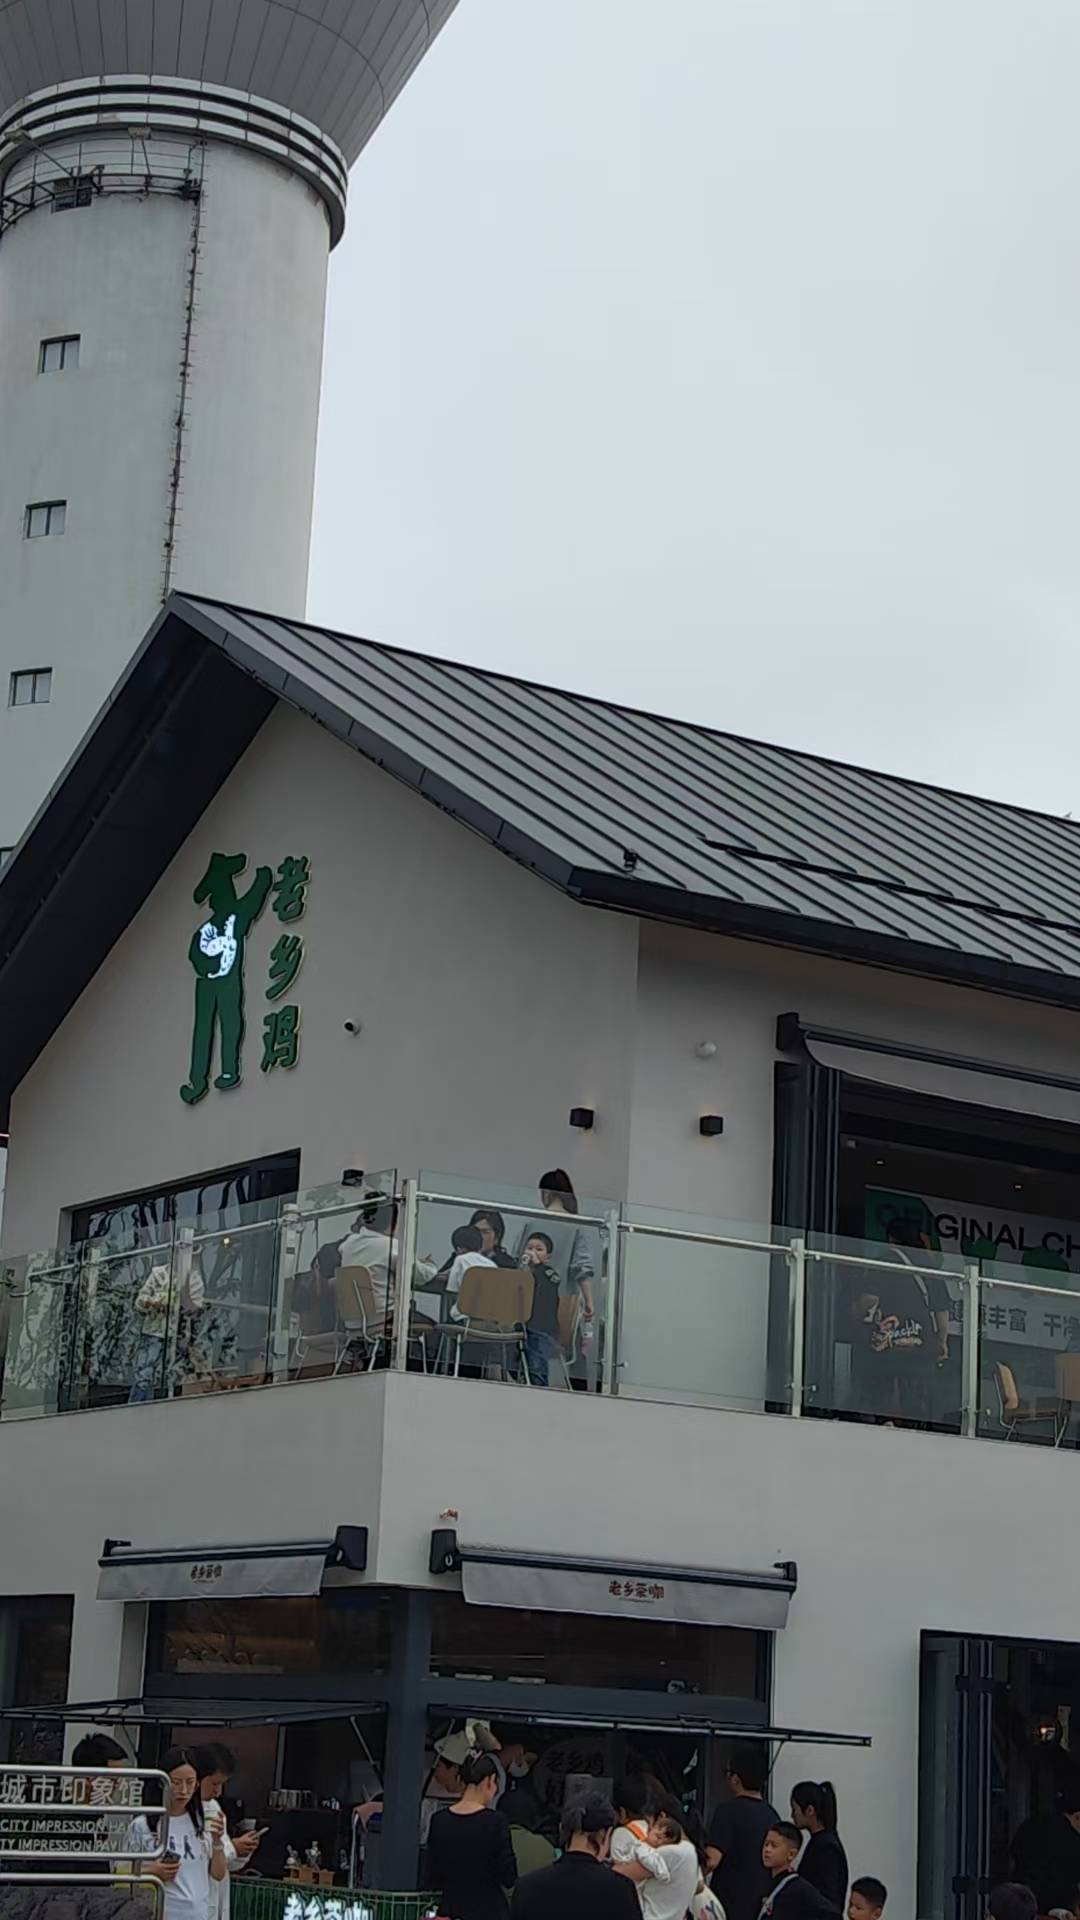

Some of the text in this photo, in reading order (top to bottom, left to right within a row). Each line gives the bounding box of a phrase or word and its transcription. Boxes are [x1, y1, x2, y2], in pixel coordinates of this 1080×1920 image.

[260, 855, 311, 1073] 老乡鸡
[608, 1580, 665, 1600] 老乡茶咖
[0, 1774, 144, 1806] 城市印象馆
[1, 1819, 29, 1832] CITY
[32, 1820, 107, 1833] IMPRESSION
[18, 1839, 93, 1851] IMPRESSION
